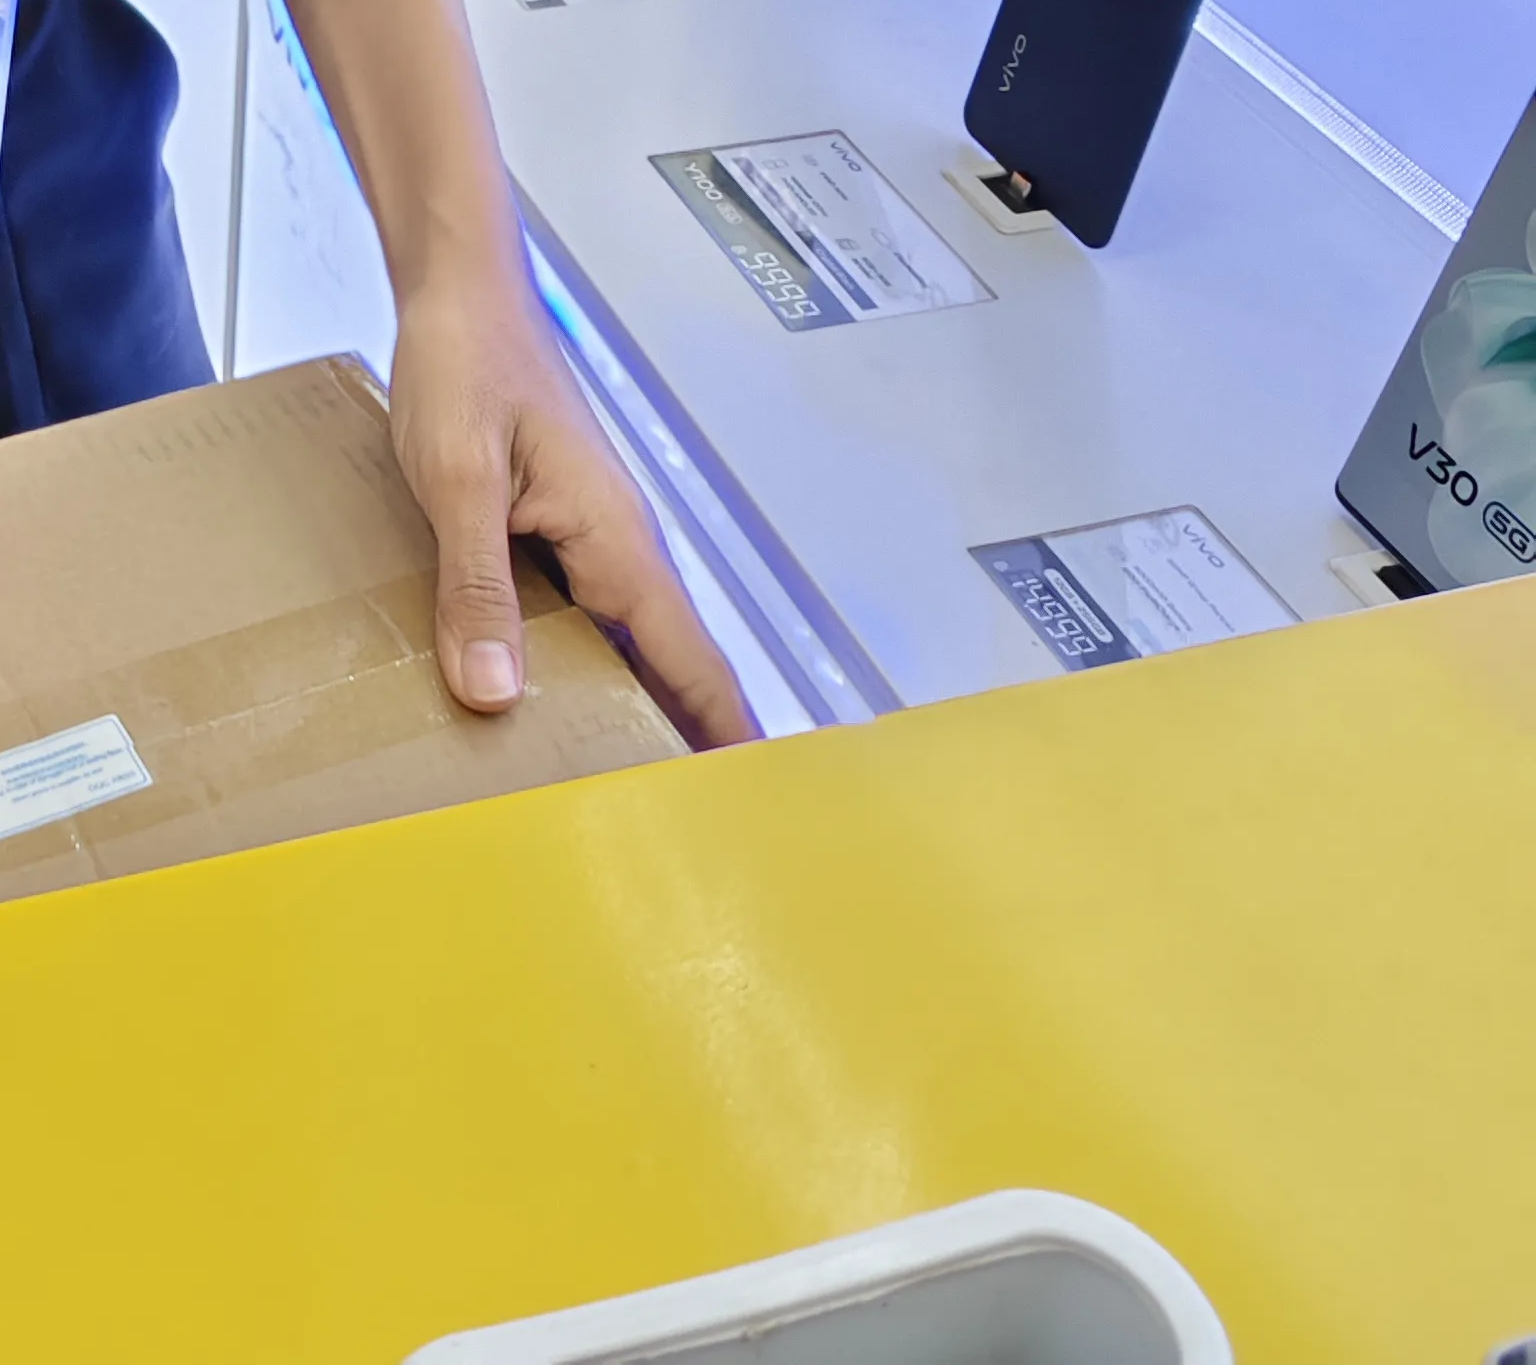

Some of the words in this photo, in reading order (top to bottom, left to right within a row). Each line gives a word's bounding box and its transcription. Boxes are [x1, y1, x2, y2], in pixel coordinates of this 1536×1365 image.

[998, 33, 1028, 92] vivo
[684, 161, 722, 202] Y100
[830, 140, 862, 173] vivo
[739, 250, 821, 320] 9999
[1408, 422, 1479, 507] V30
[1489, 509, 1531, 556] 5G
[1182, 523, 1226, 569] vivo
